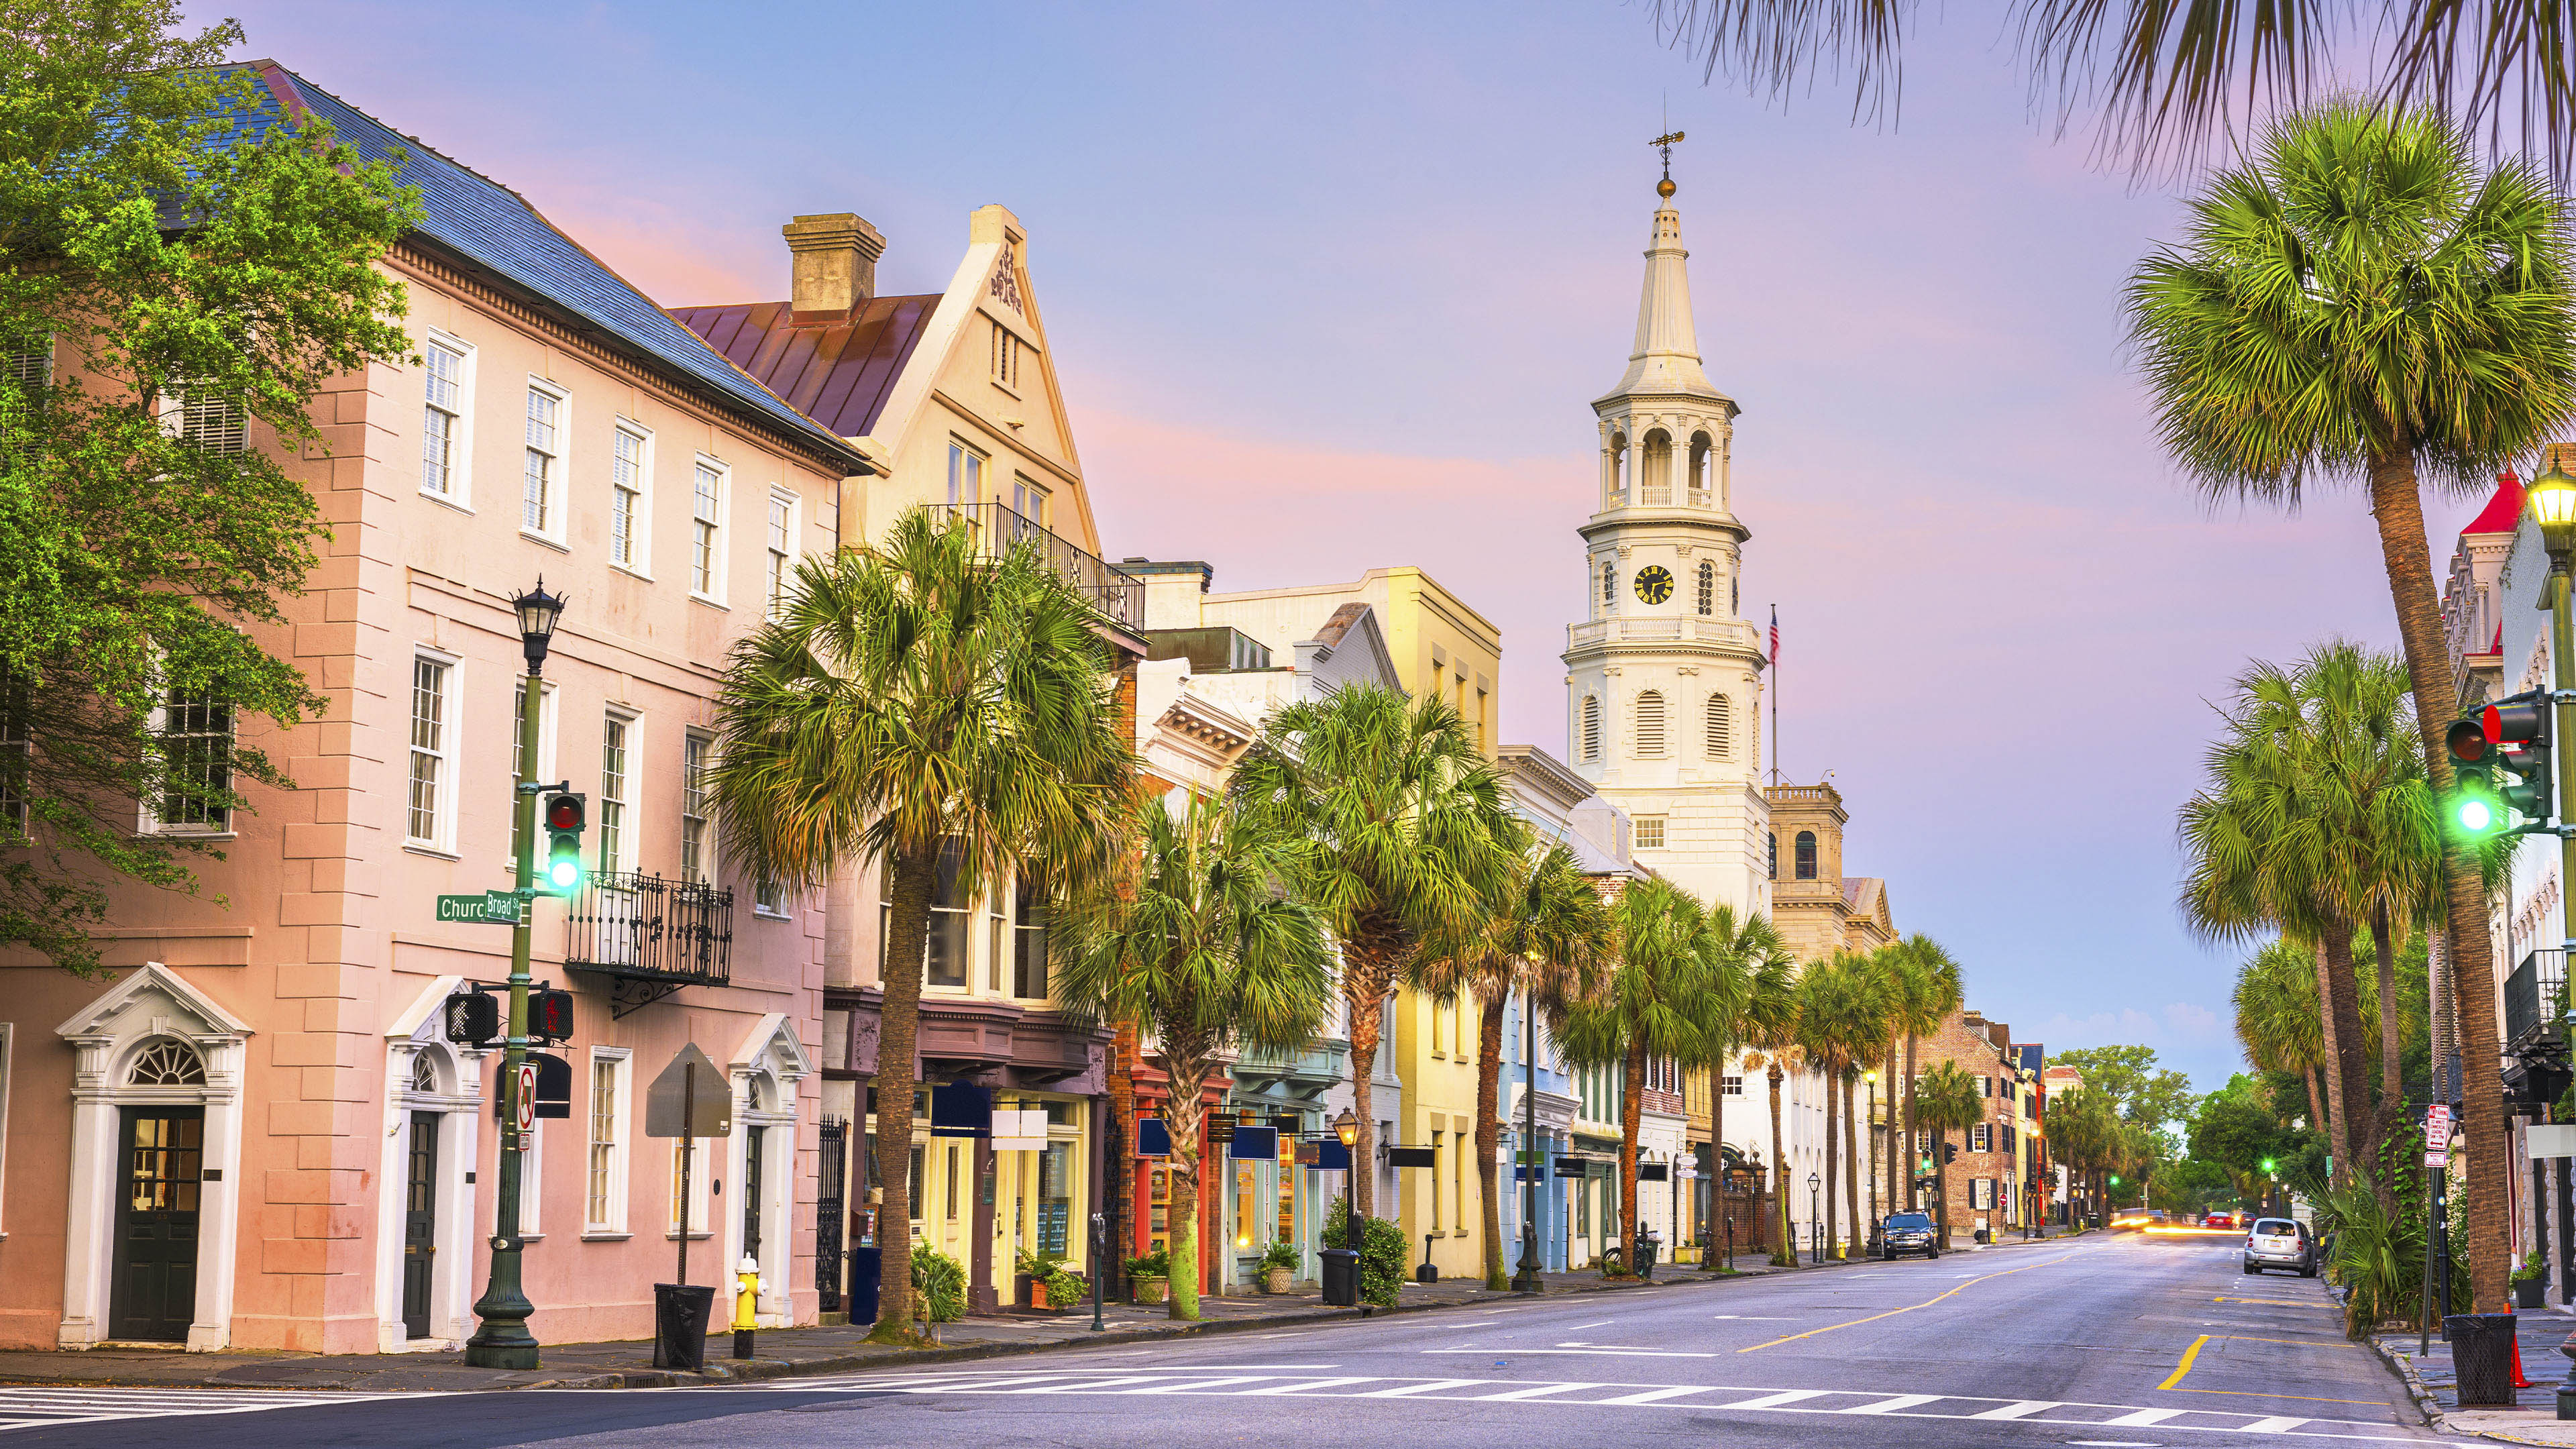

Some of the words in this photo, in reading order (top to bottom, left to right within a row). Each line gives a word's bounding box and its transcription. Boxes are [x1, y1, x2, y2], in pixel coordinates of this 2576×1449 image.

[441, 898, 484, 918] Churc
[487, 894, 512, 915] Broad
[2429, 1108, 2435, 1116] NO
